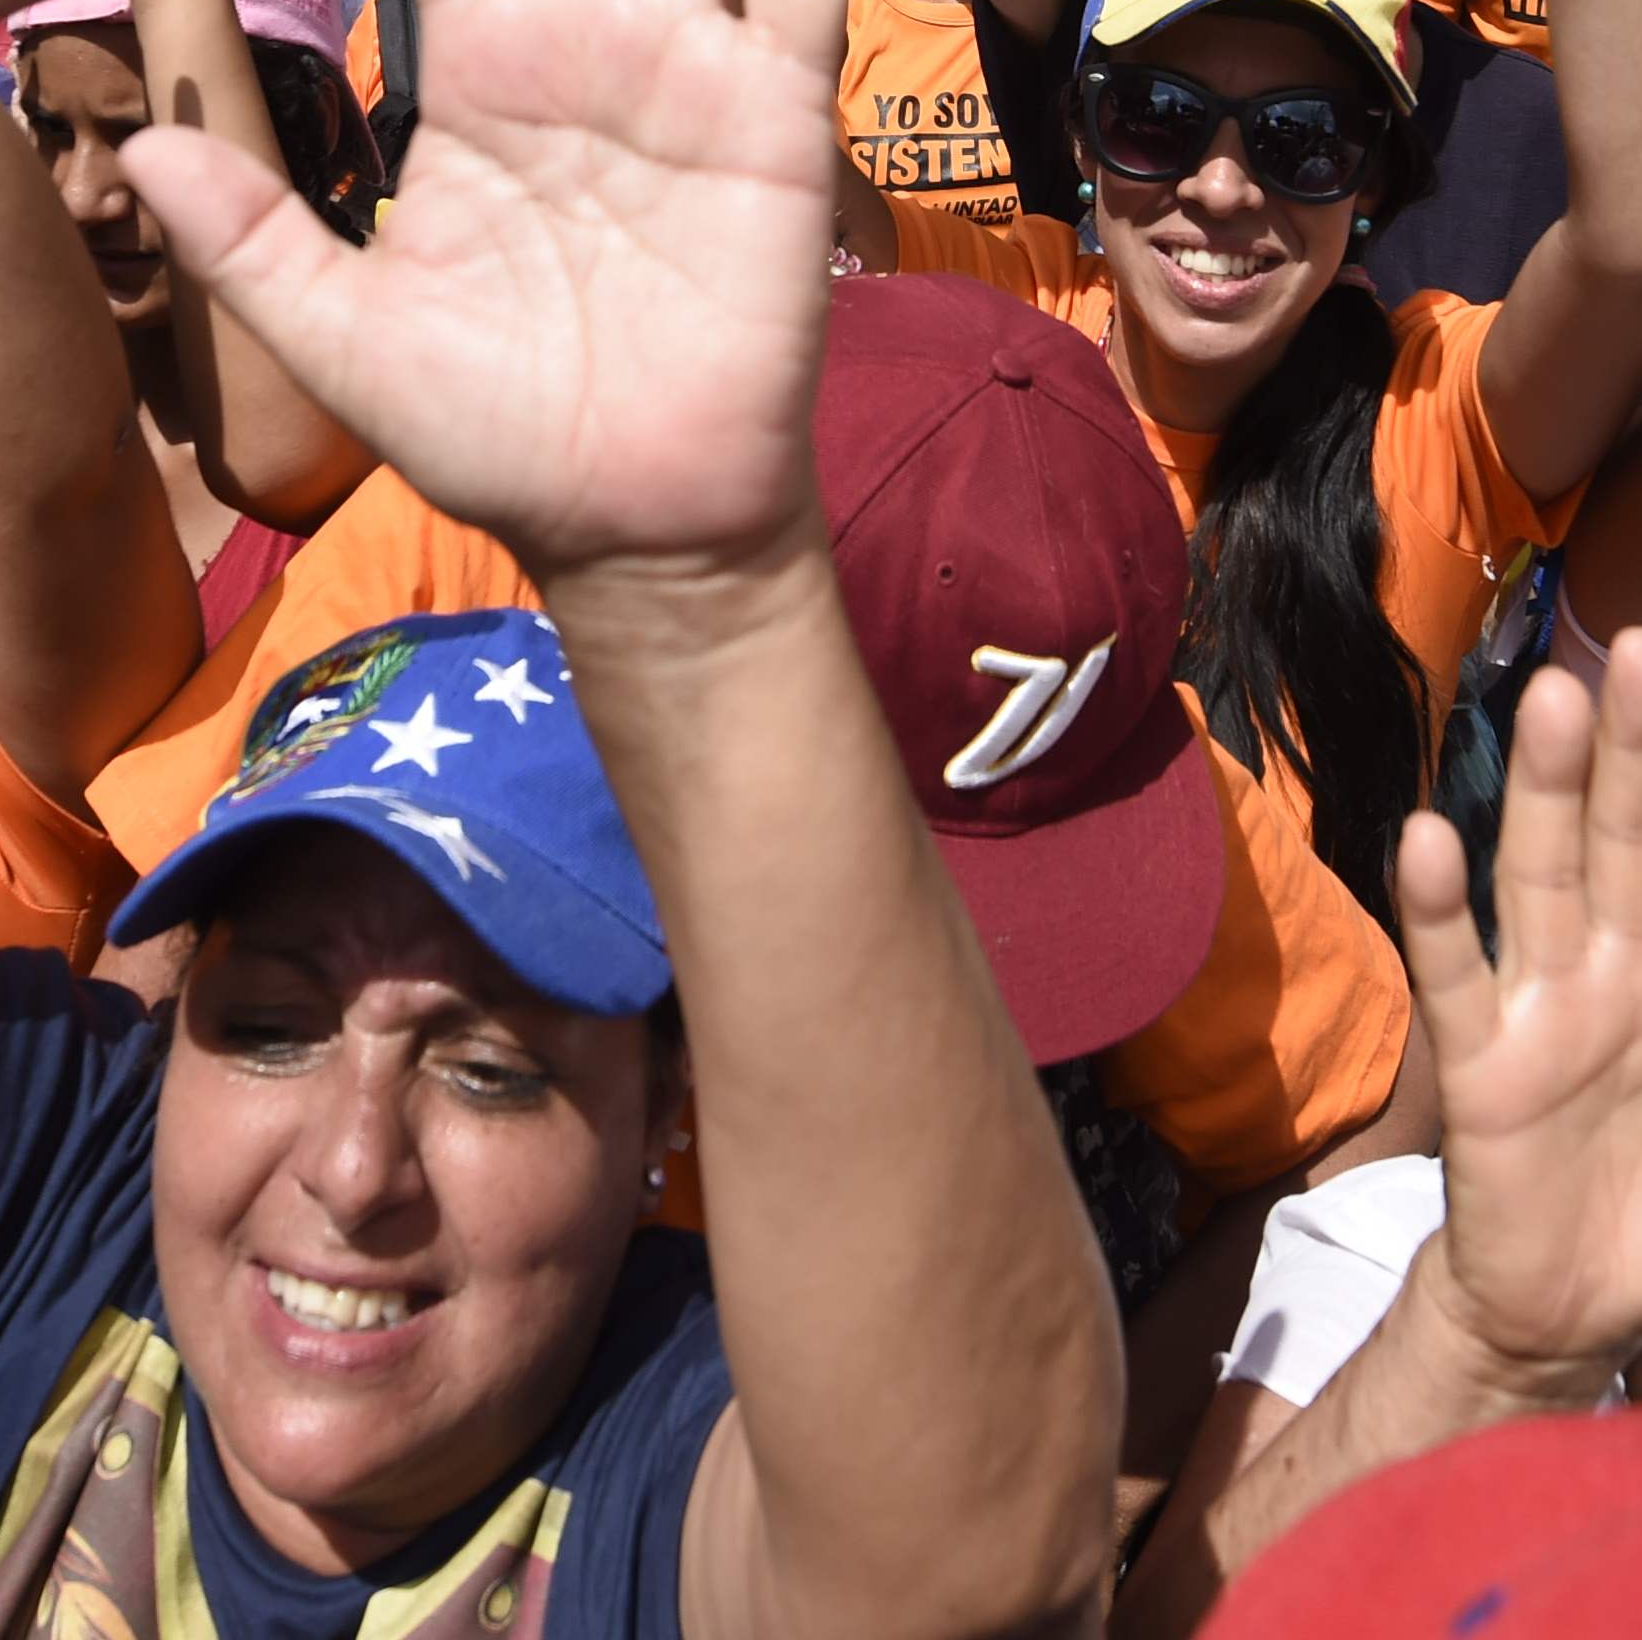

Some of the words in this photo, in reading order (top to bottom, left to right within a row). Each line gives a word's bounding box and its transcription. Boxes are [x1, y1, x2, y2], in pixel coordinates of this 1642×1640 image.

[873, 95, 921, 130] YO
[851, 139, 1012, 187] SISTEN
[945, 196, 1018, 217] UNTAD
